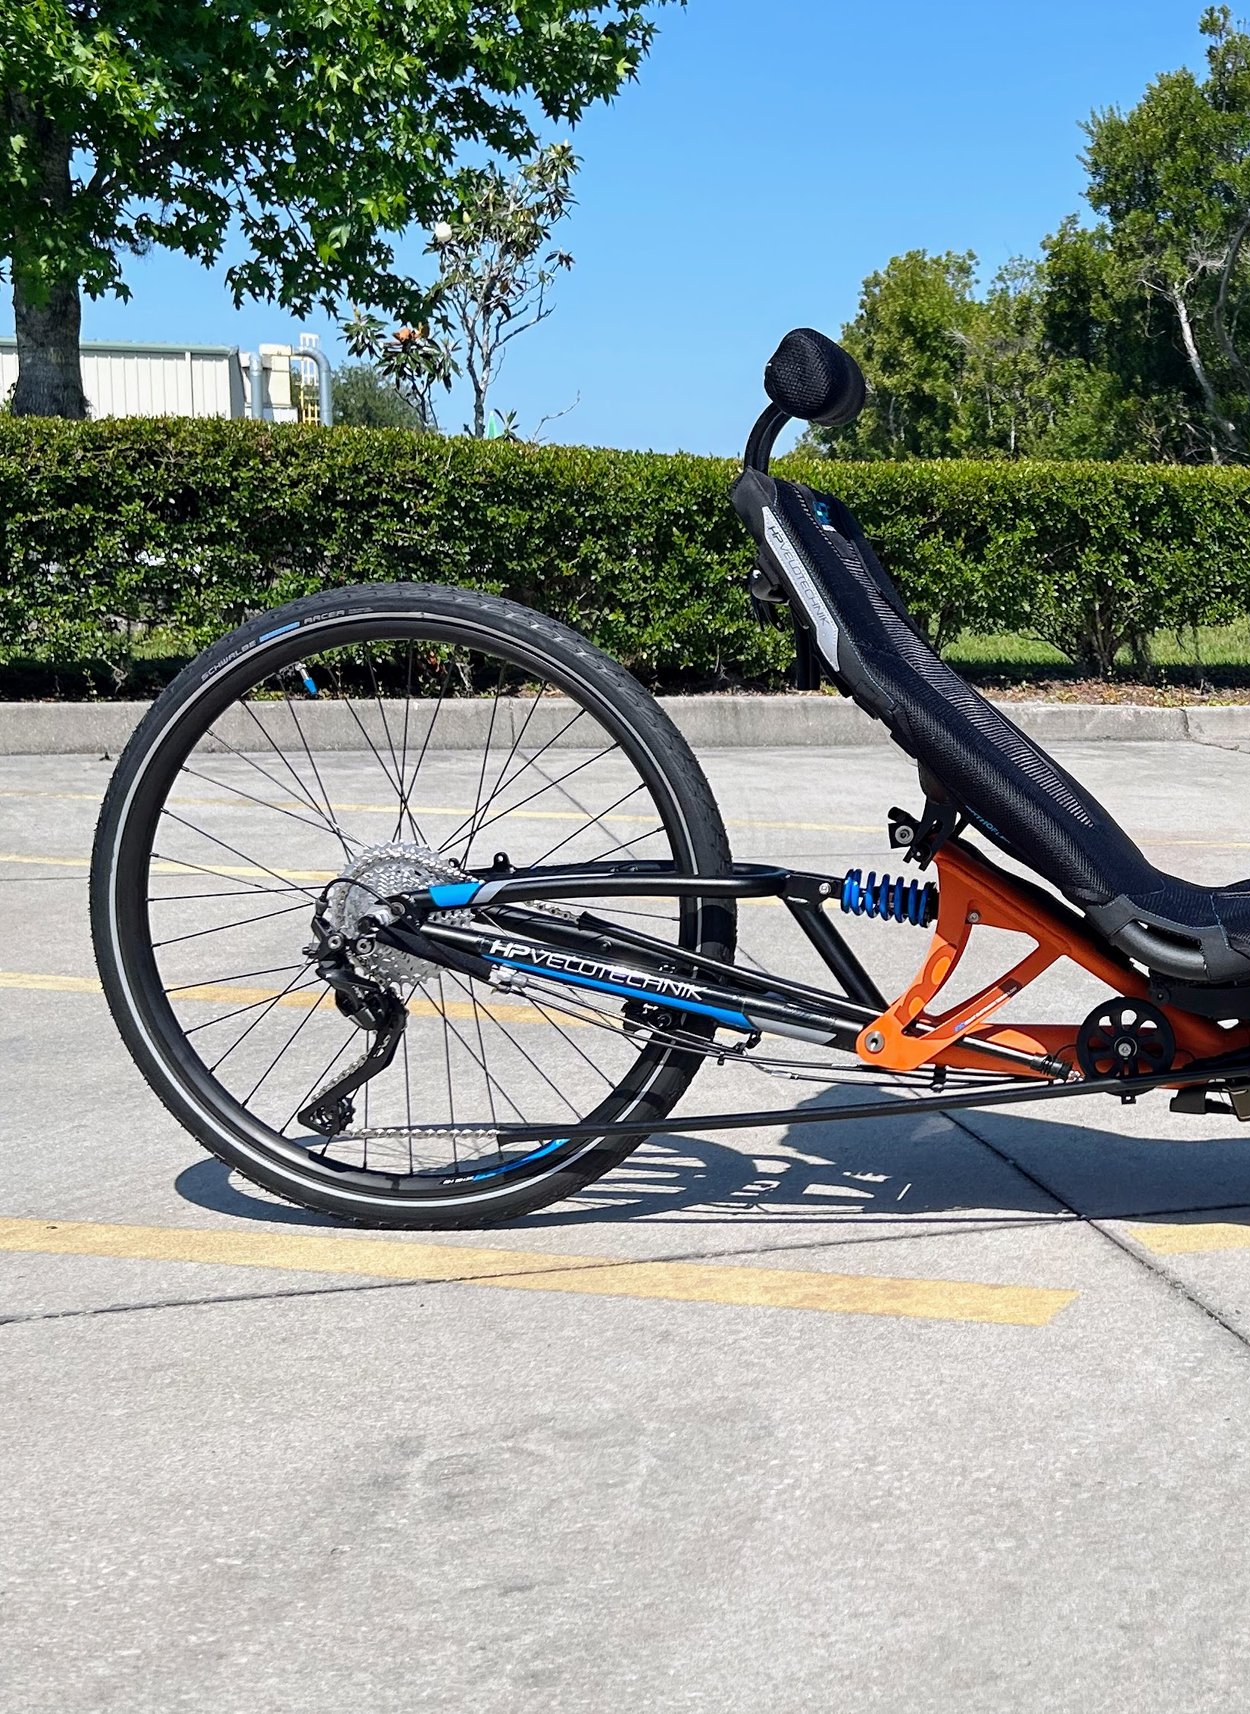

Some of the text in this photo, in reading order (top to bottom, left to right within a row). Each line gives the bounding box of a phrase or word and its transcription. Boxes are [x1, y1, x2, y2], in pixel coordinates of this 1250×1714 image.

[303, 609, 346, 625] RACER
[201, 639, 258, 682] SCHWALBE
[489, 939, 709, 1002] HPVELOTECHNIK
